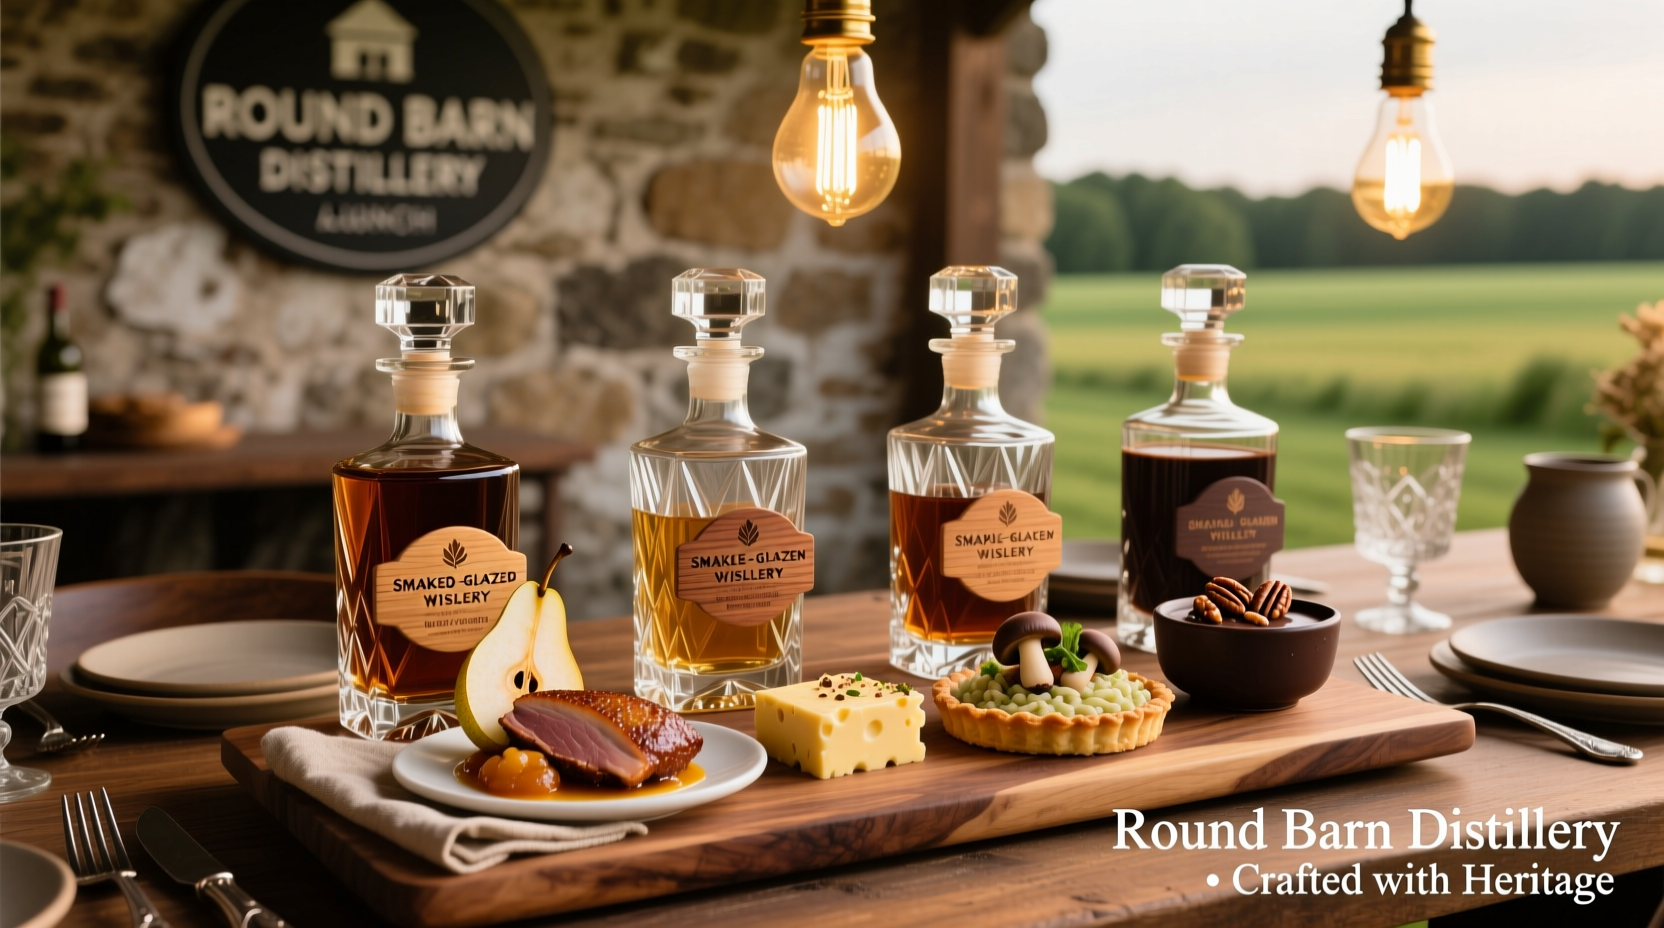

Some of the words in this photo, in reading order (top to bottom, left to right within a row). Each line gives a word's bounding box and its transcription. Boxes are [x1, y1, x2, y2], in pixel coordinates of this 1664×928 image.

[202, 84, 394, 146] ROUND
[403, 94, 536, 152] BARN
[259, 147, 487, 197] DISTILLERY
[977, 545, 1034, 560] WISLERY
[714, 567, 784, 583] WISLLERY
[423, 590, 491, 608] WISLERY
